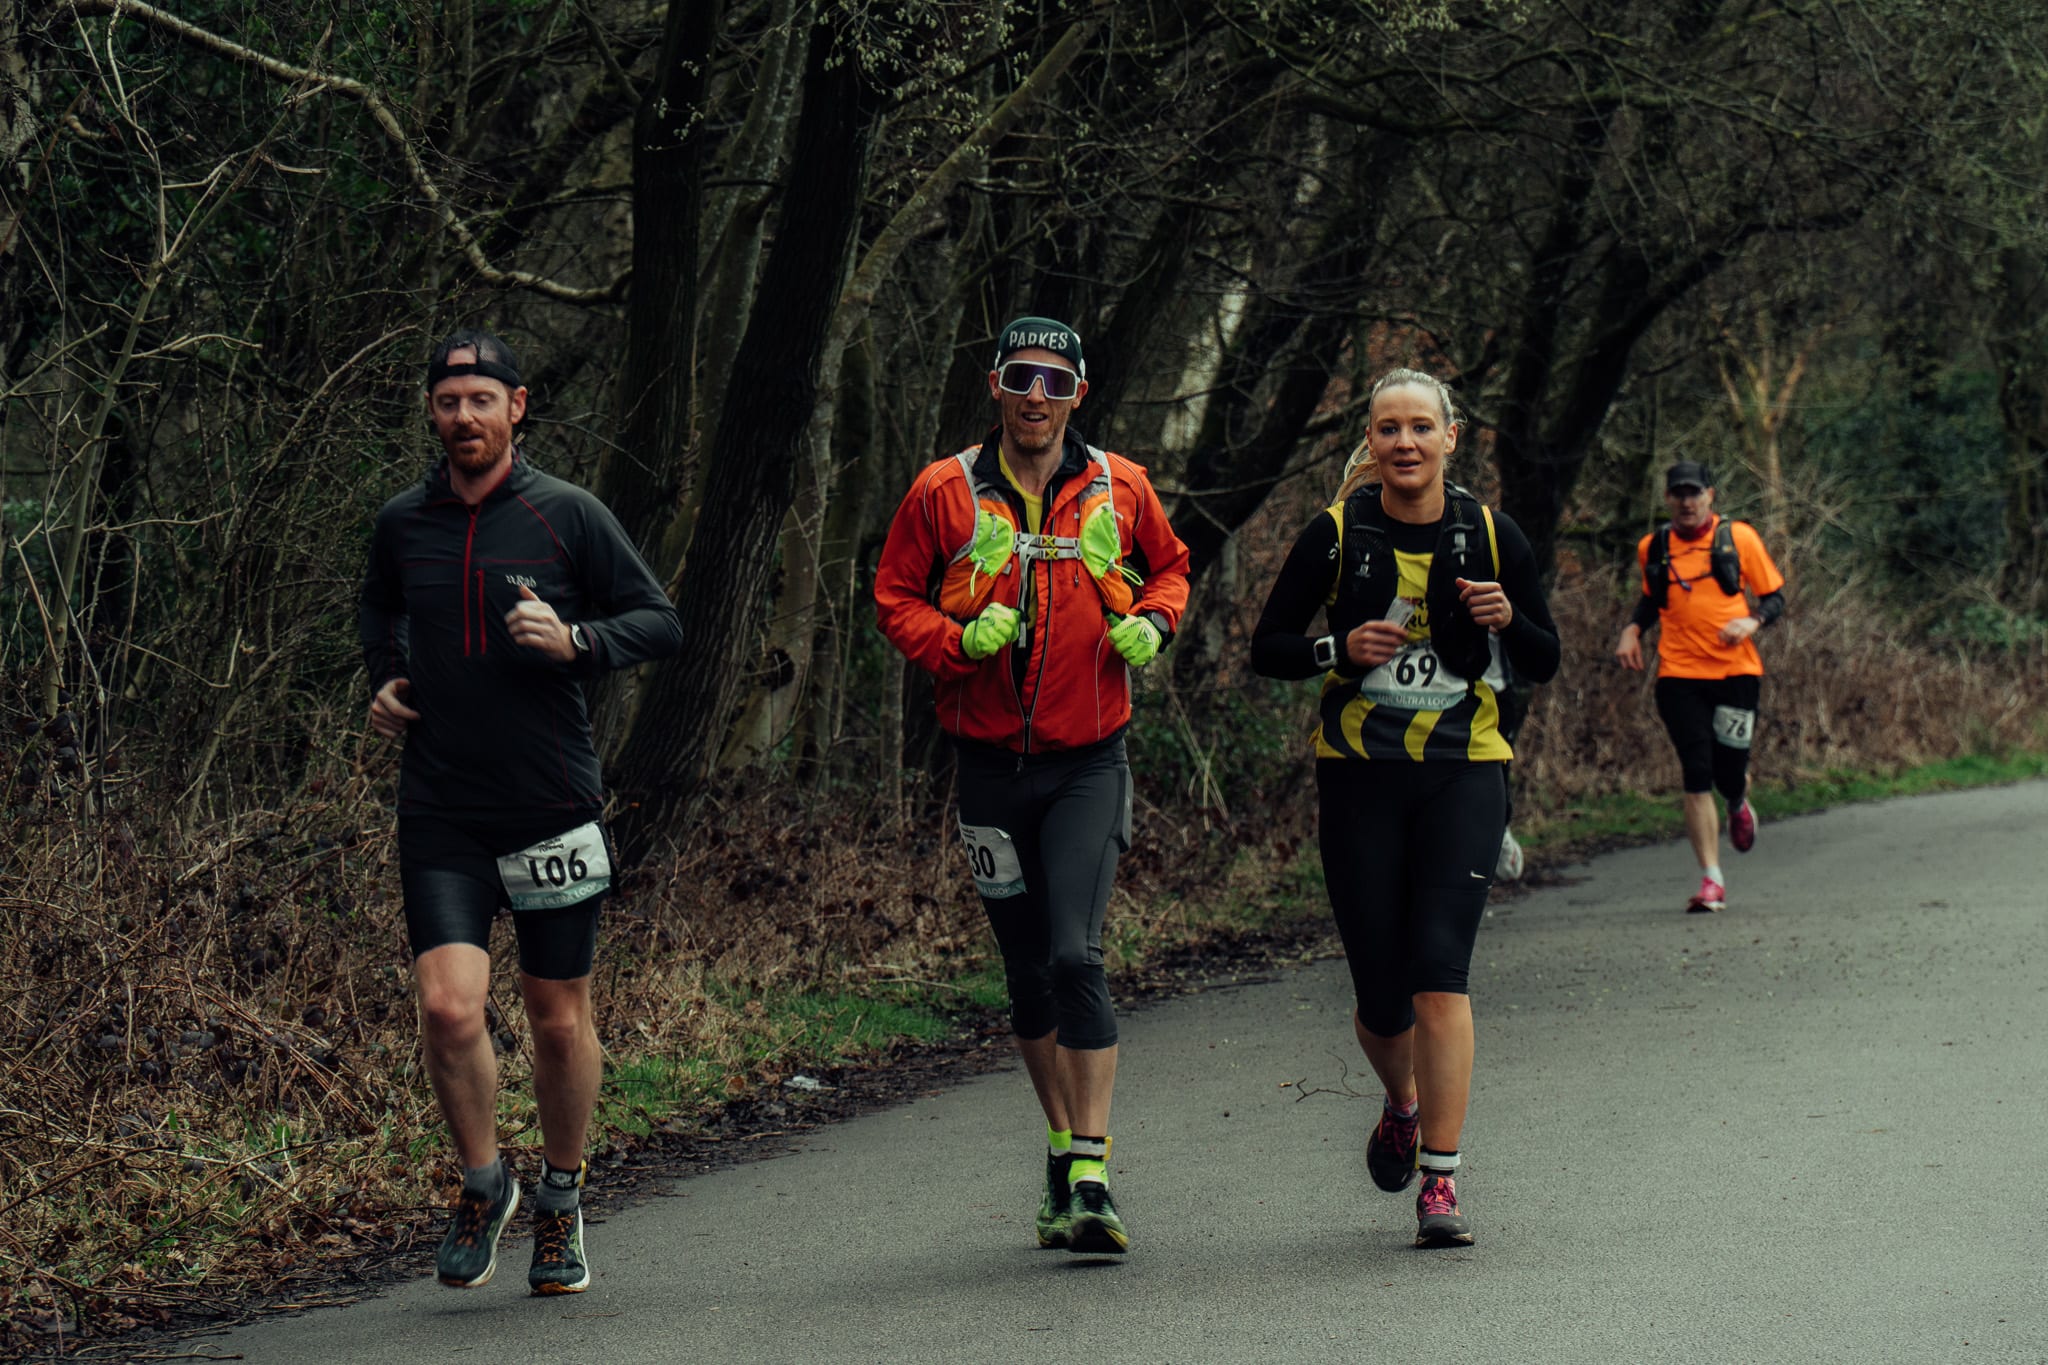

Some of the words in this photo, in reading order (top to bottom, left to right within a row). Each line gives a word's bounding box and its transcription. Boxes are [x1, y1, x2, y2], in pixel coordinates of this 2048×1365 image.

[1009, 331, 1068, 349] PARKES
[1396, 653, 1437, 688] 69
[528, 848, 588, 888] 106
